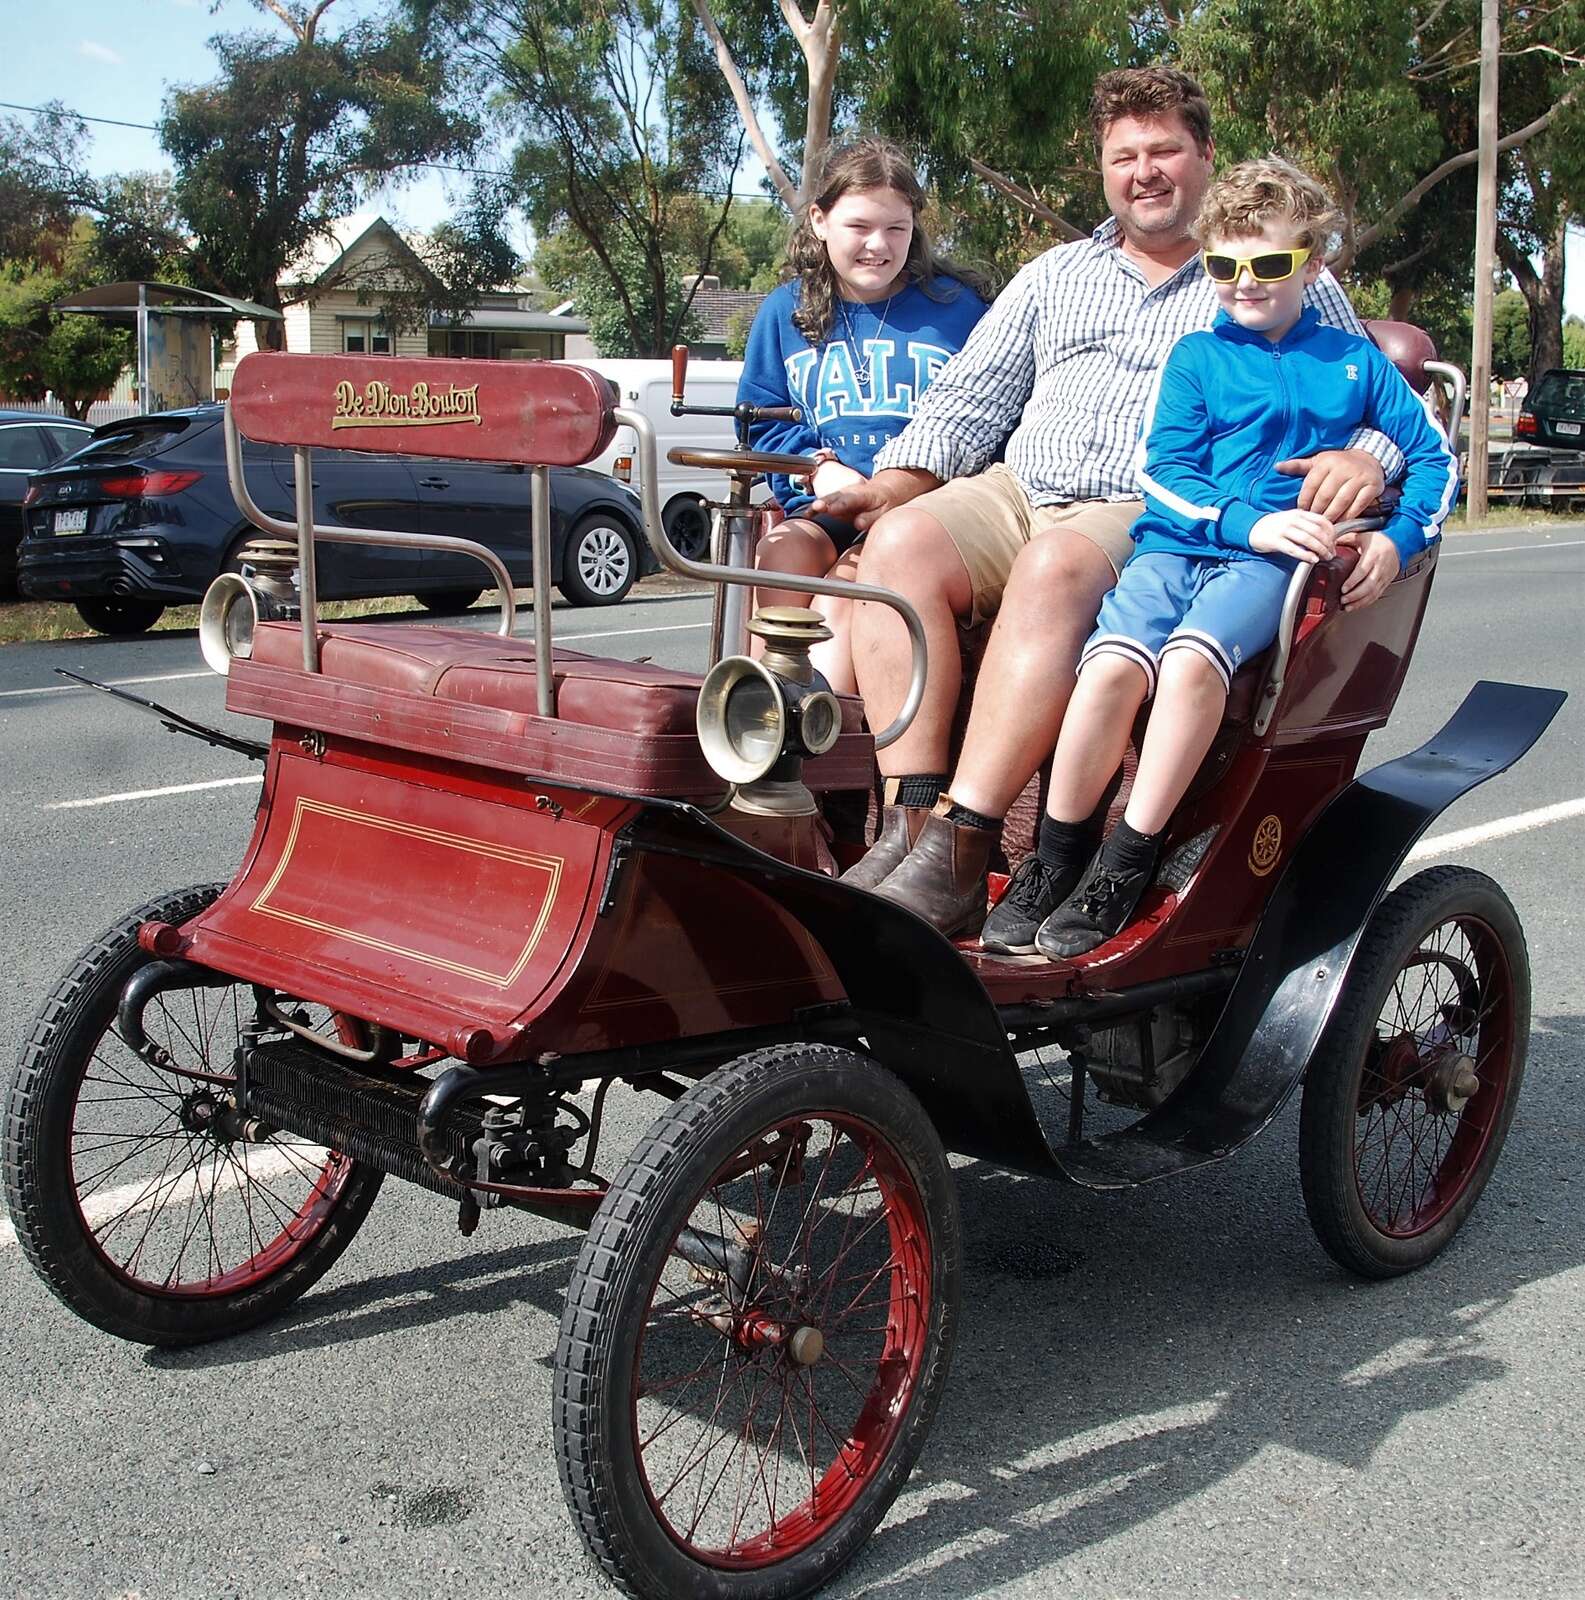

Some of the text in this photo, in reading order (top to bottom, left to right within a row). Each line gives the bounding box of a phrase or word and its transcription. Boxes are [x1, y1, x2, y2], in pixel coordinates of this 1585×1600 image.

[335, 380, 482, 422] De Dion Bouton
